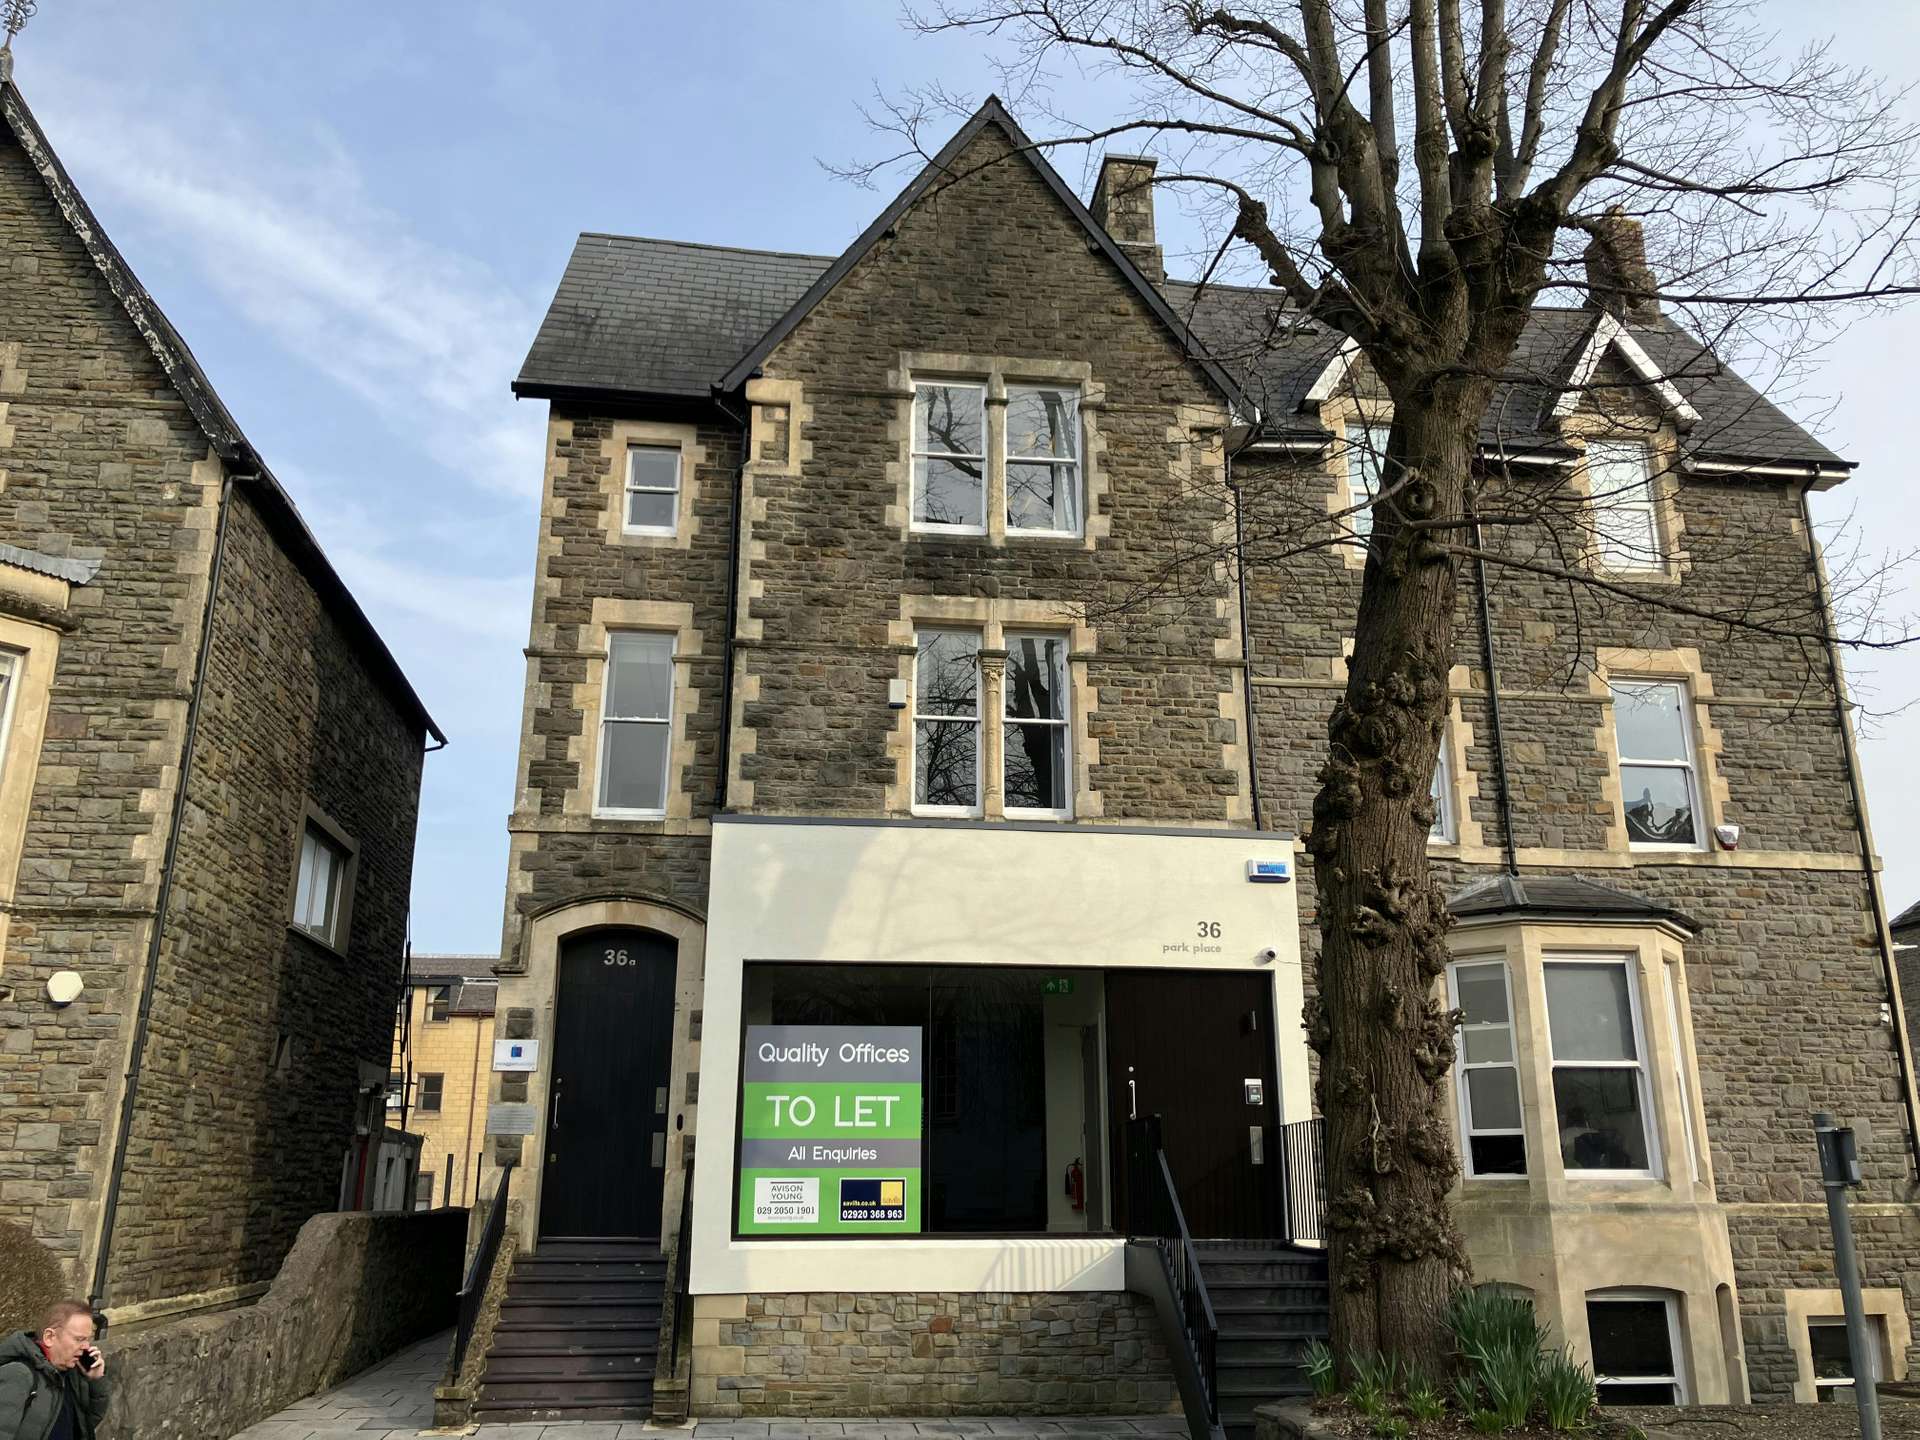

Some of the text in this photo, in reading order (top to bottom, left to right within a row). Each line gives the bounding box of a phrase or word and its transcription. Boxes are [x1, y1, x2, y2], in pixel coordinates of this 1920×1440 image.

[1197, 921, 1221, 938] 36
[1162, 942, 1222, 955] park place
[758, 1042, 910, 1067] Quality Offices
[766, 1095, 900, 1127] TO LET
[788, 1146, 877, 1163] All Enquiries
[771, 1184, 803, 1192] AVISON
[771, 1192, 803, 1200] YOUNG
[757, 1206, 815, 1215] 029 2050 1901
[842, 1210, 903, 1219] 02920 368 963
